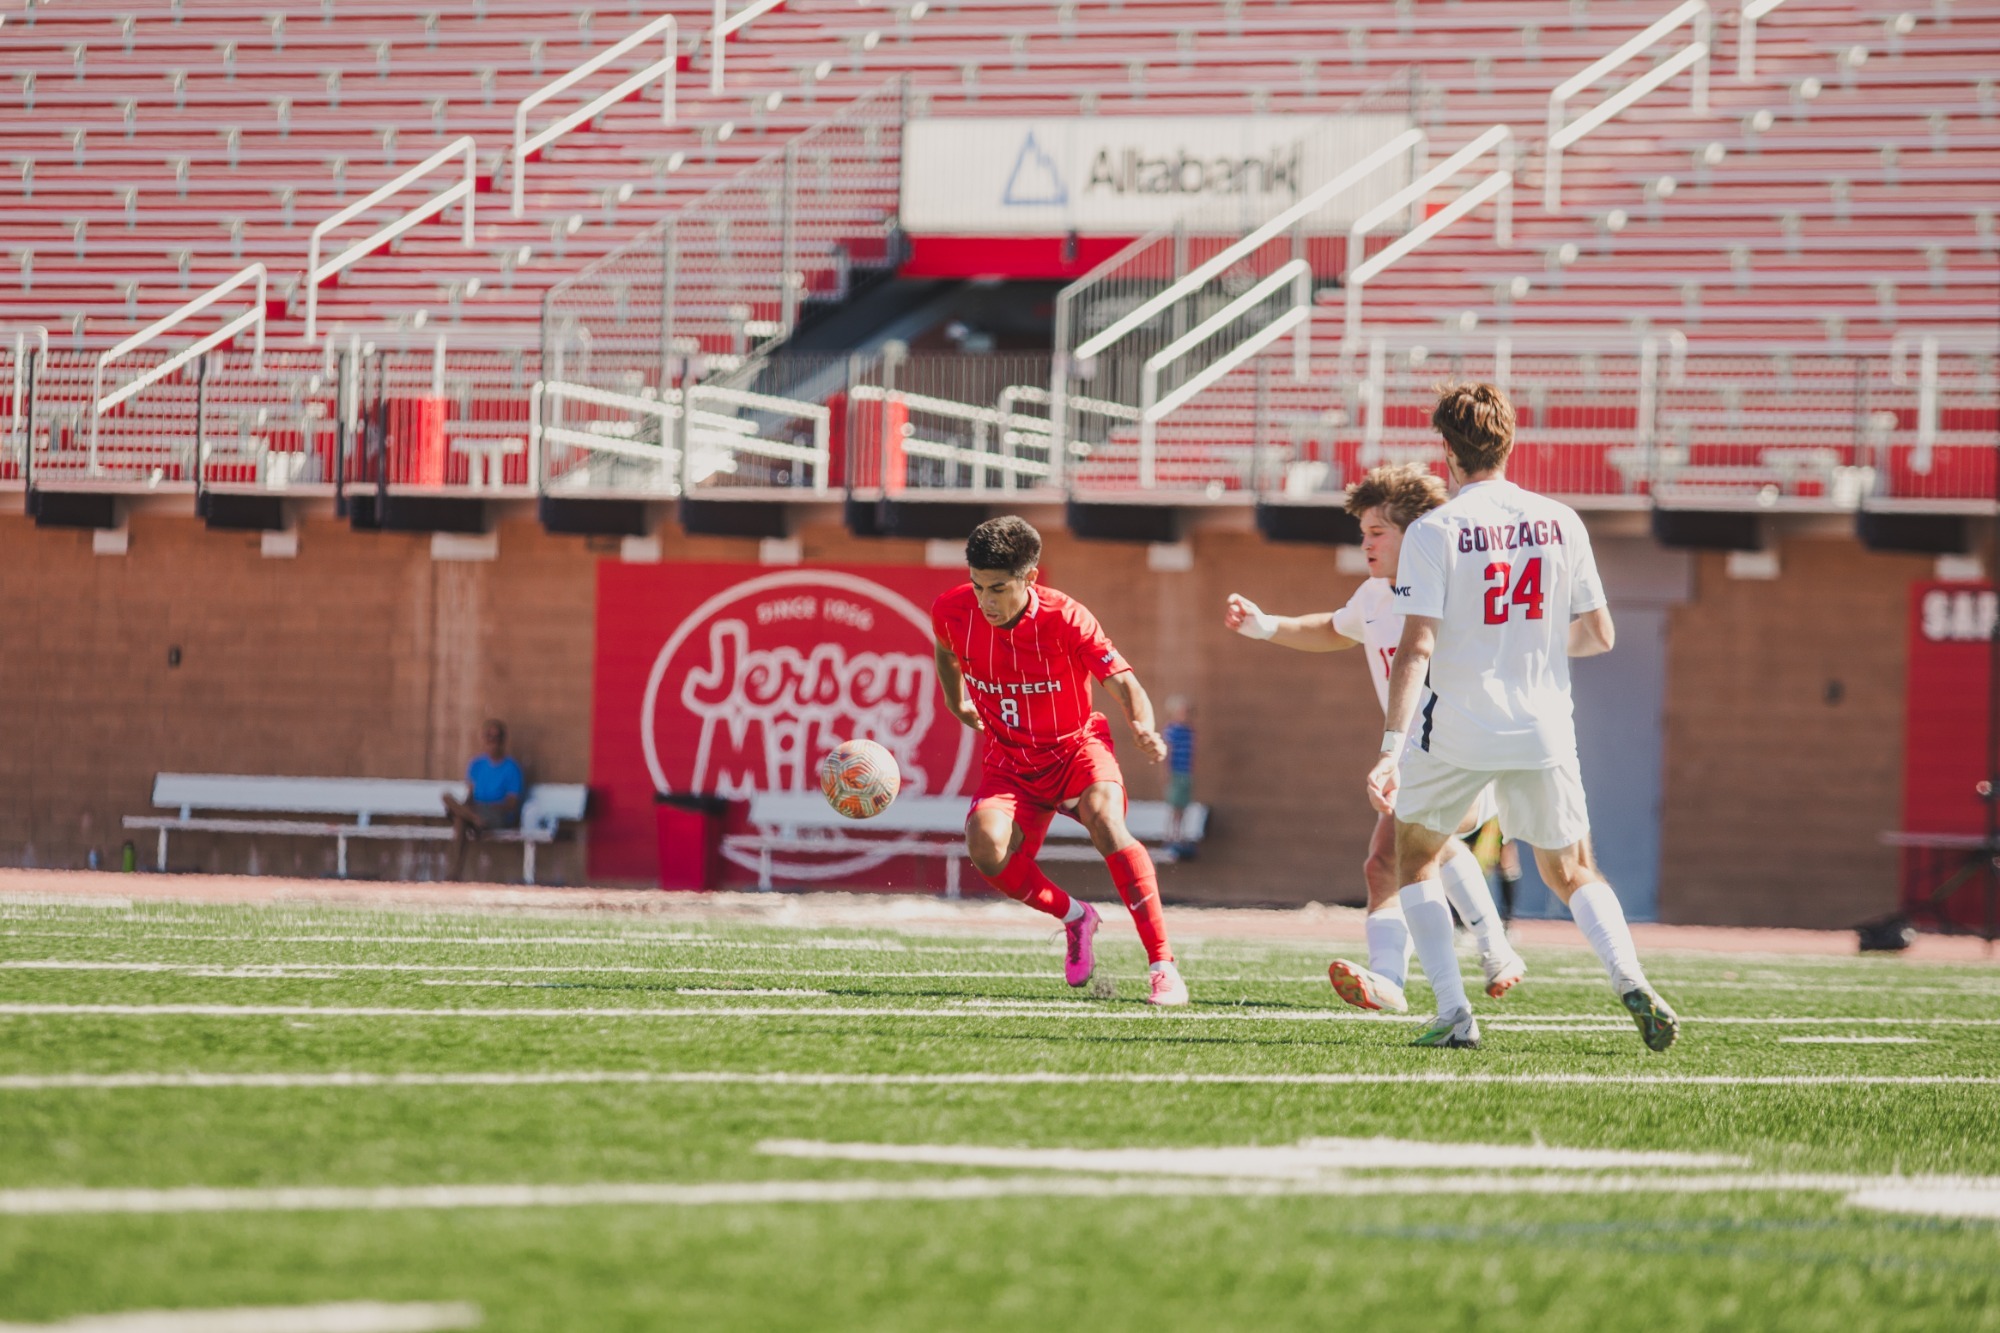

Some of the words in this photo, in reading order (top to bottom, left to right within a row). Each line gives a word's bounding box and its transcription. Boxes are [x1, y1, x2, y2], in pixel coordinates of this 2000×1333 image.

[1086, 147, 1303, 194] Altabank
[1458, 520, 1563, 553] GONZAGA
[1484, 557, 1544, 625] 24
[756, 596, 817, 625] SINCE
[1379, 647, 1397, 681] 1
[1007, 680, 1062, 695] TECH
[1000, 698, 1020, 728] 8
